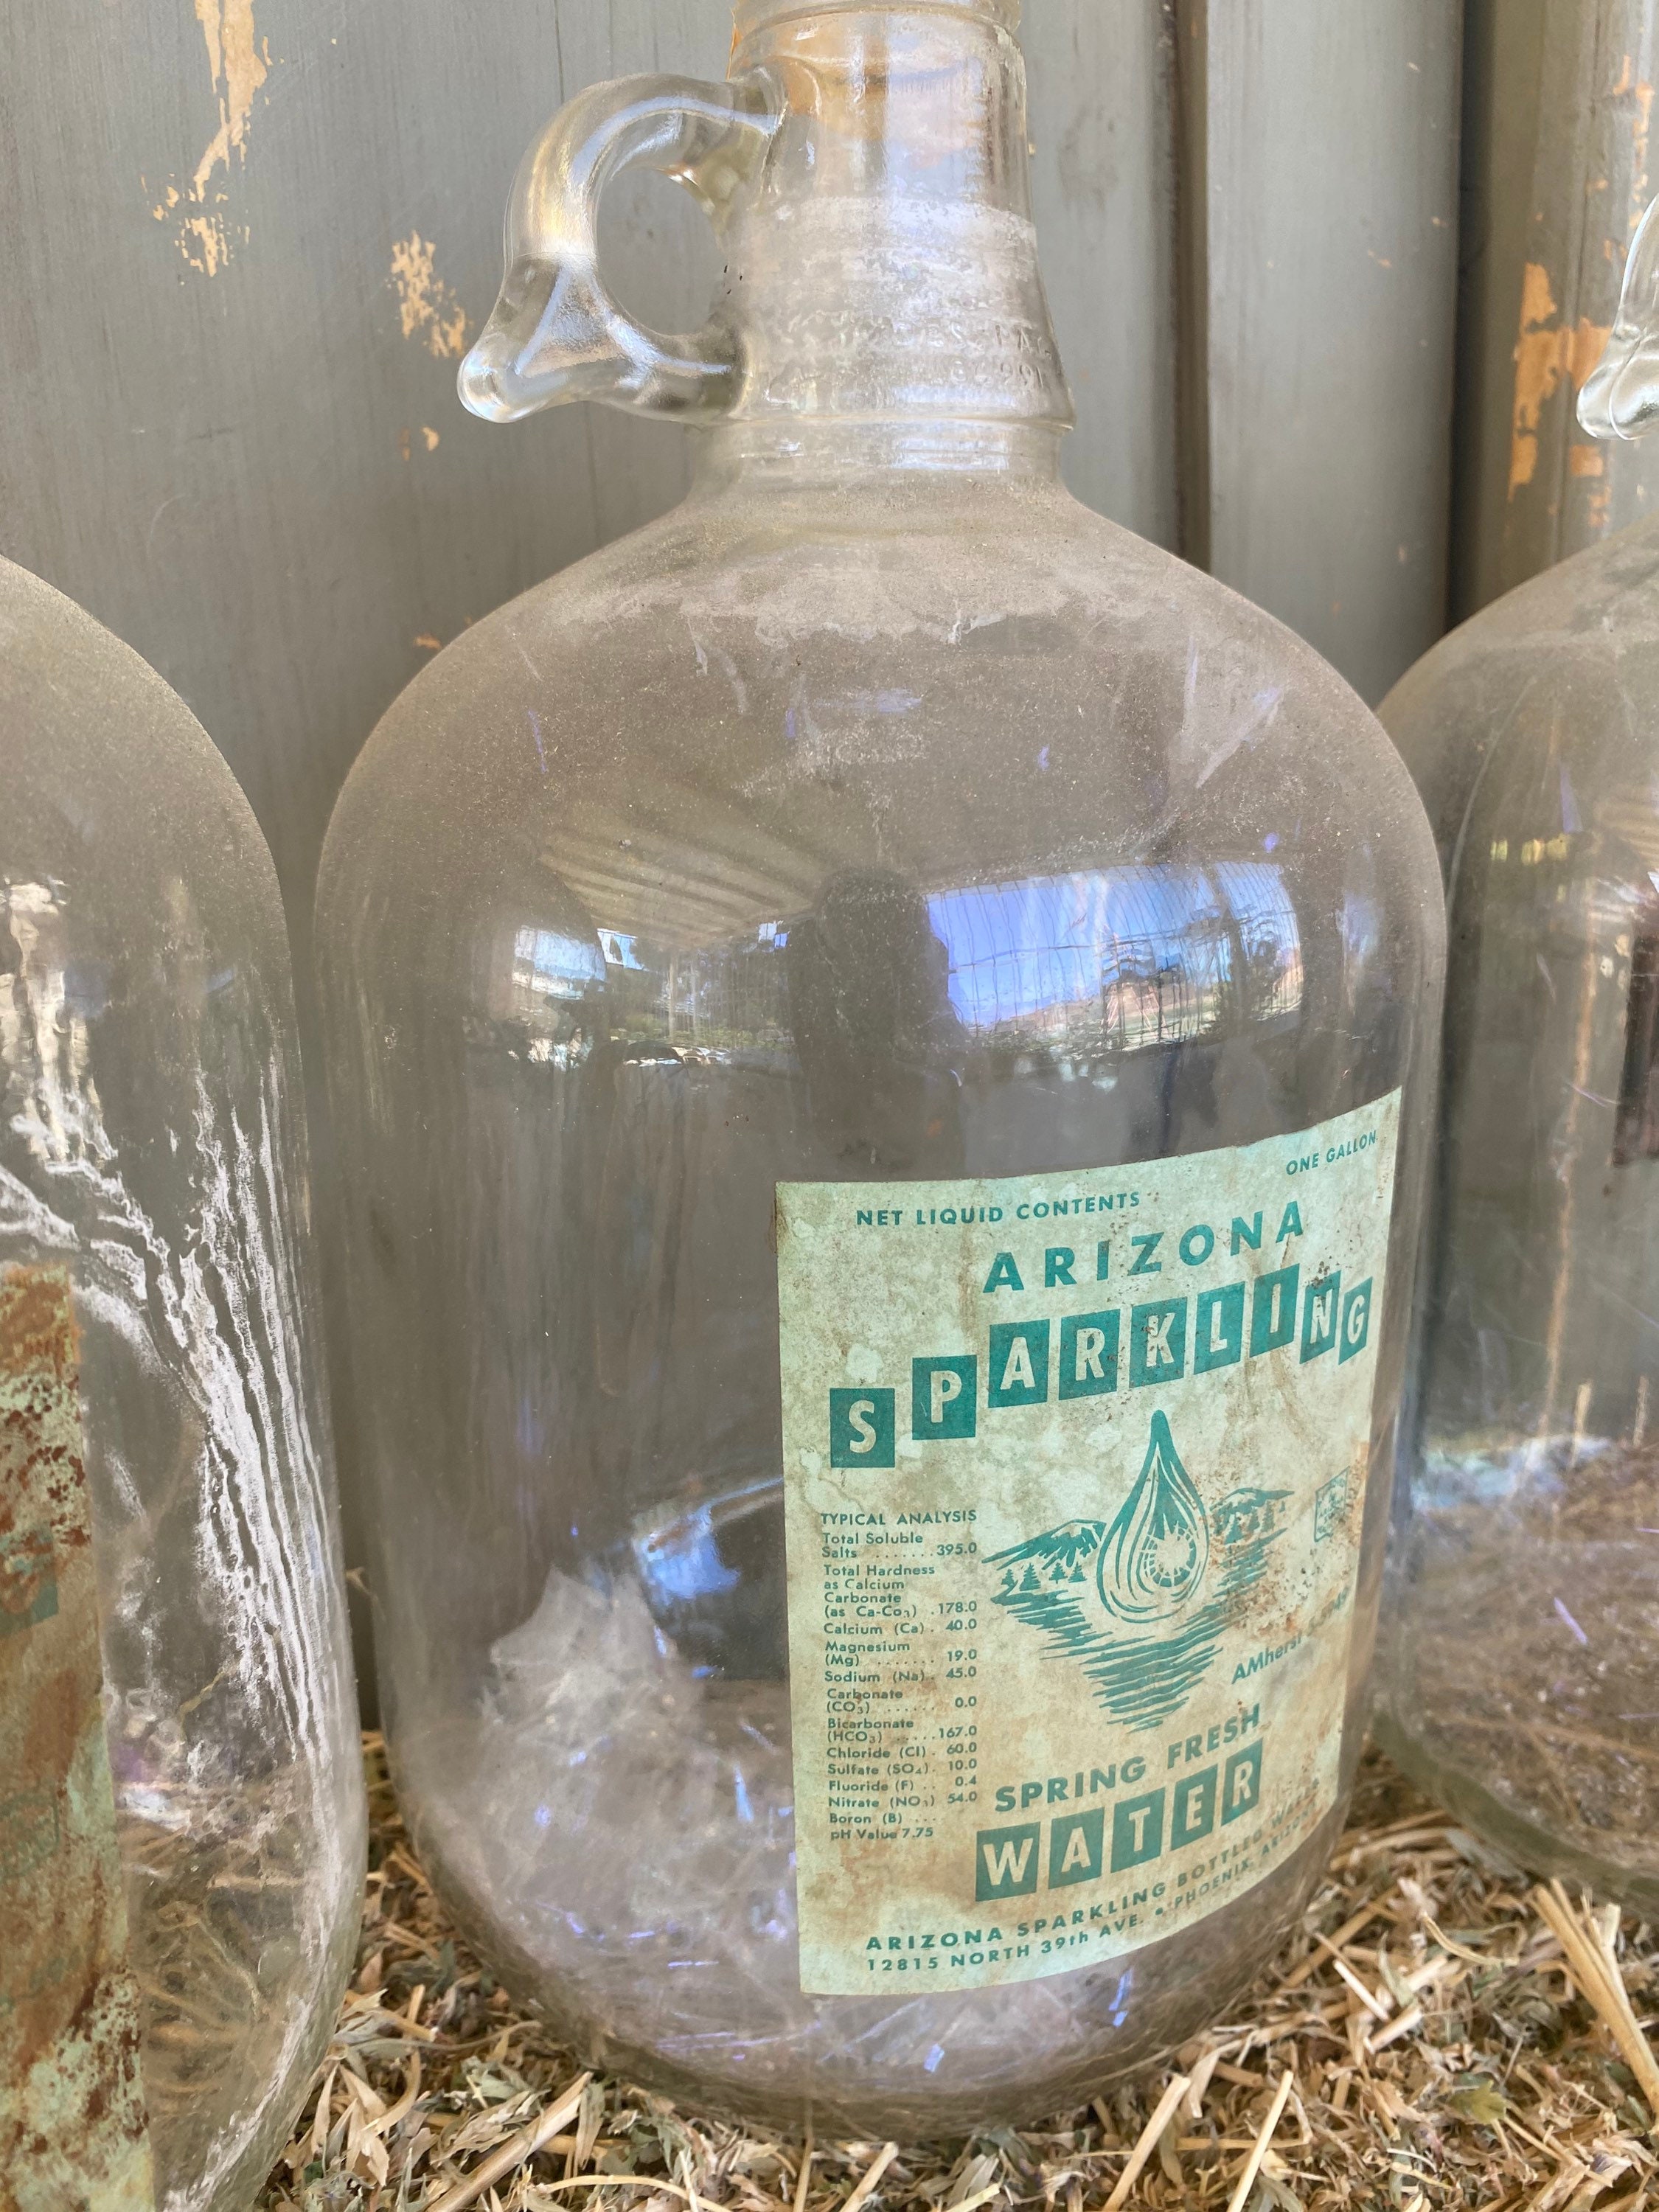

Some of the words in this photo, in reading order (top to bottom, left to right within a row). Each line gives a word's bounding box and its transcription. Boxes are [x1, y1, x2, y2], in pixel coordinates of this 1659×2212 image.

[1286, 1152, 1319, 1175] ONE
[1326, 1130, 1377, 1164] GALLON
[856, 1209, 902, 1226] NET
[916, 1207, 1004, 1225] LIQUID
[1016, 1192, 1141, 1220] CONTENTS
[982, 1200, 1304, 1293] ARIZONA
[849, 1283, 1366, 1454] SPARKLING
[821, 1513, 886, 1526] TYPICAL
[897, 1509, 977, 1525] ANALYSIS
[822, 1532, 859, 1544] Total
[866, 1532, 924, 1544] Soluble
[821, 1546, 857, 1558] Salts
[936, 1543, 977, 1556] 395.0
[824, 1564, 860, 1576] Total
[866, 1564, 935, 1576] Hardness
[824, 1582, 838, 1590] as
[845, 1579, 905, 1590] Calcium
[824, 1592, 902, 1603] Carbonate
[825, 1605, 846, 1618] (as
[939, 1601, 977, 1614] 178.0
[824, 1623, 883, 1635] Calcium
[894, 1622, 924, 1635] (Ca)
[946, 1618, 977, 1631] 40.0
[825, 1641, 910, 1654] Magnesium
[826, 1654, 860, 1667] (Mg)
[947, 1649, 977, 1661] 19.0
[824, 1671, 880, 1683] Sodium
[893, 1670, 925, 1683] (Na)
[946, 1666, 977, 1679] 45.0
[827, 1688, 903, 1699] Carbonate
[955, 1696, 977, 1708] 0.0
[828, 1718, 914, 1729] Bicarbonate
[939, 1725, 977, 1739] 167.0
[827, 1747, 891, 1759] Chloride
[900, 1746, 926, 1759] (Cl)
[947, 1742, 977, 1754] 60.0
[995, 1756, 1147, 1812] SPRING
[1167, 1703, 1260, 1770] FRESH
[827, 1764, 879, 1775] Sulfate
[949, 1759, 977, 1770] 10.0
[829, 1781, 888, 1791] Fluoride
[895, 1780, 914, 1792] (F)
[955, 1775, 977, 1787] 0.4
[829, 1797, 880, 1807] Nitrate
[947, 1791, 977, 1804] 54.0
[830, 1813, 872, 1823] Boron
[883, 1813, 902, 1824] (B)
[983, 1760, 1253, 1886] WATER
[831, 1830, 852, 1840] pH
[857, 1829, 897, 1839] Value
[902, 1827, 933, 1838] 7.75
[866, 1927, 1003, 1951] ARIZONA
[1017, 1882, 1166, 1937] SPARKLING
[1178, 1829, 1263, 1888] BOTTLED
[868, 1957, 939, 1972] 12815
[950, 1944, 1029, 1967] NORTH
[1041, 1931, 1089, 1954] 39th
[1099, 1913, 1144, 1938] AVE.
